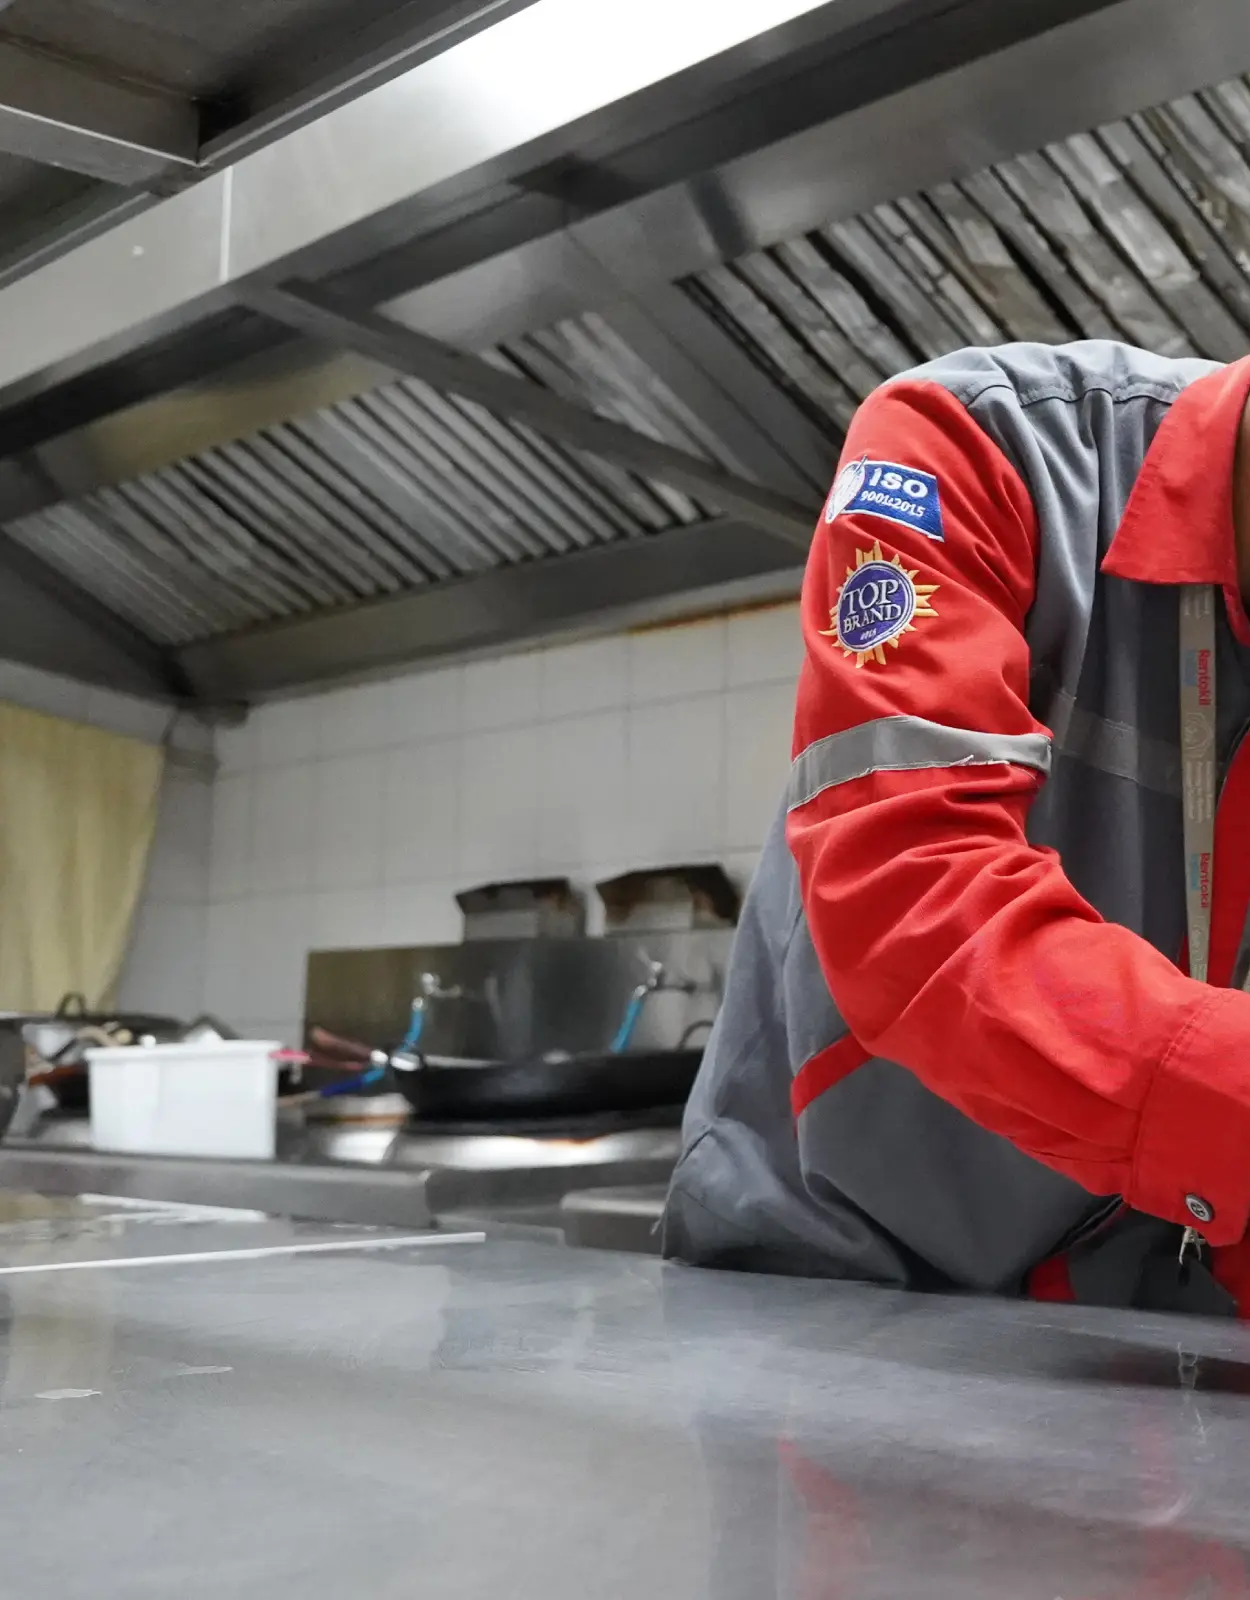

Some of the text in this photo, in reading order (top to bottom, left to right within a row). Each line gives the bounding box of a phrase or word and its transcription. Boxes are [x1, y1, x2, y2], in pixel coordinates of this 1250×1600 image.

[868, 467, 929, 498] ISO
[843, 579, 899, 616] TOP
[842, 603, 902, 634] BRAND
